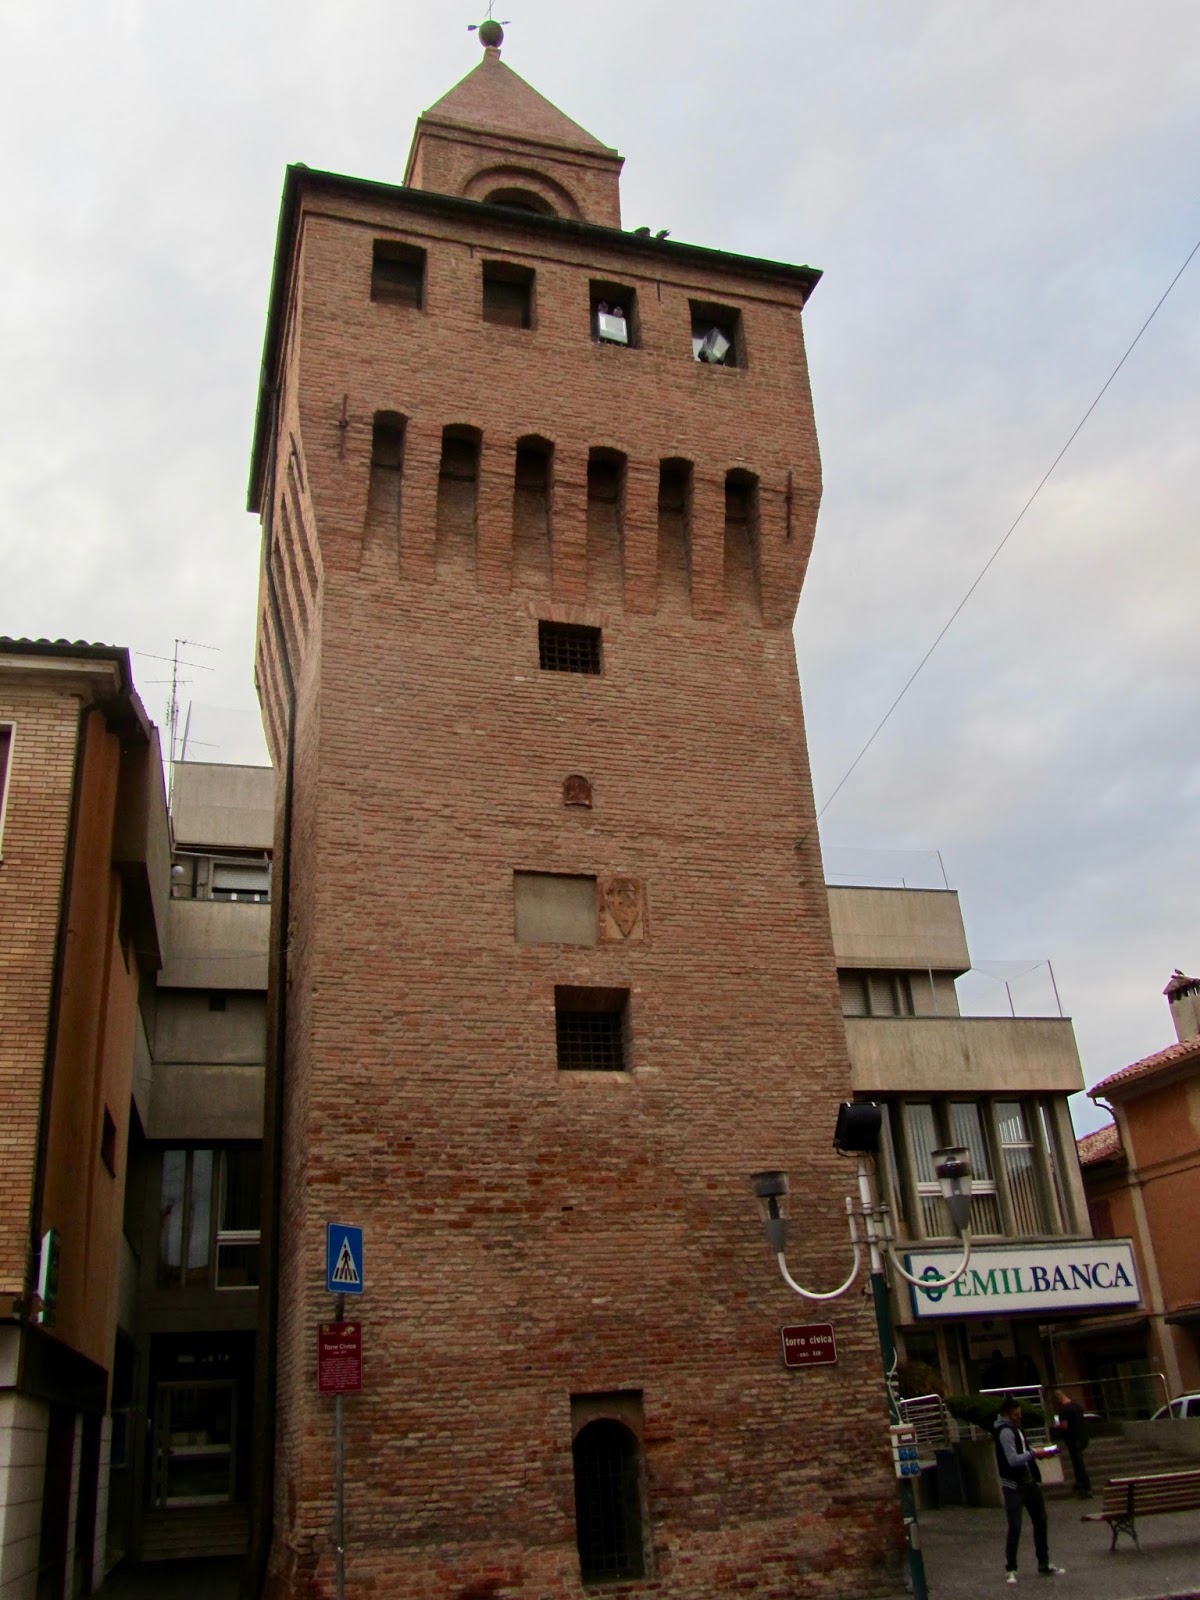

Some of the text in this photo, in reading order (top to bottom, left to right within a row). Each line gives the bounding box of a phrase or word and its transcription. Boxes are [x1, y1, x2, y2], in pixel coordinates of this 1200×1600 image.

[950, 1261, 1133, 1297] EMILBANCA
[785, 1335, 832, 1346] torre civica
